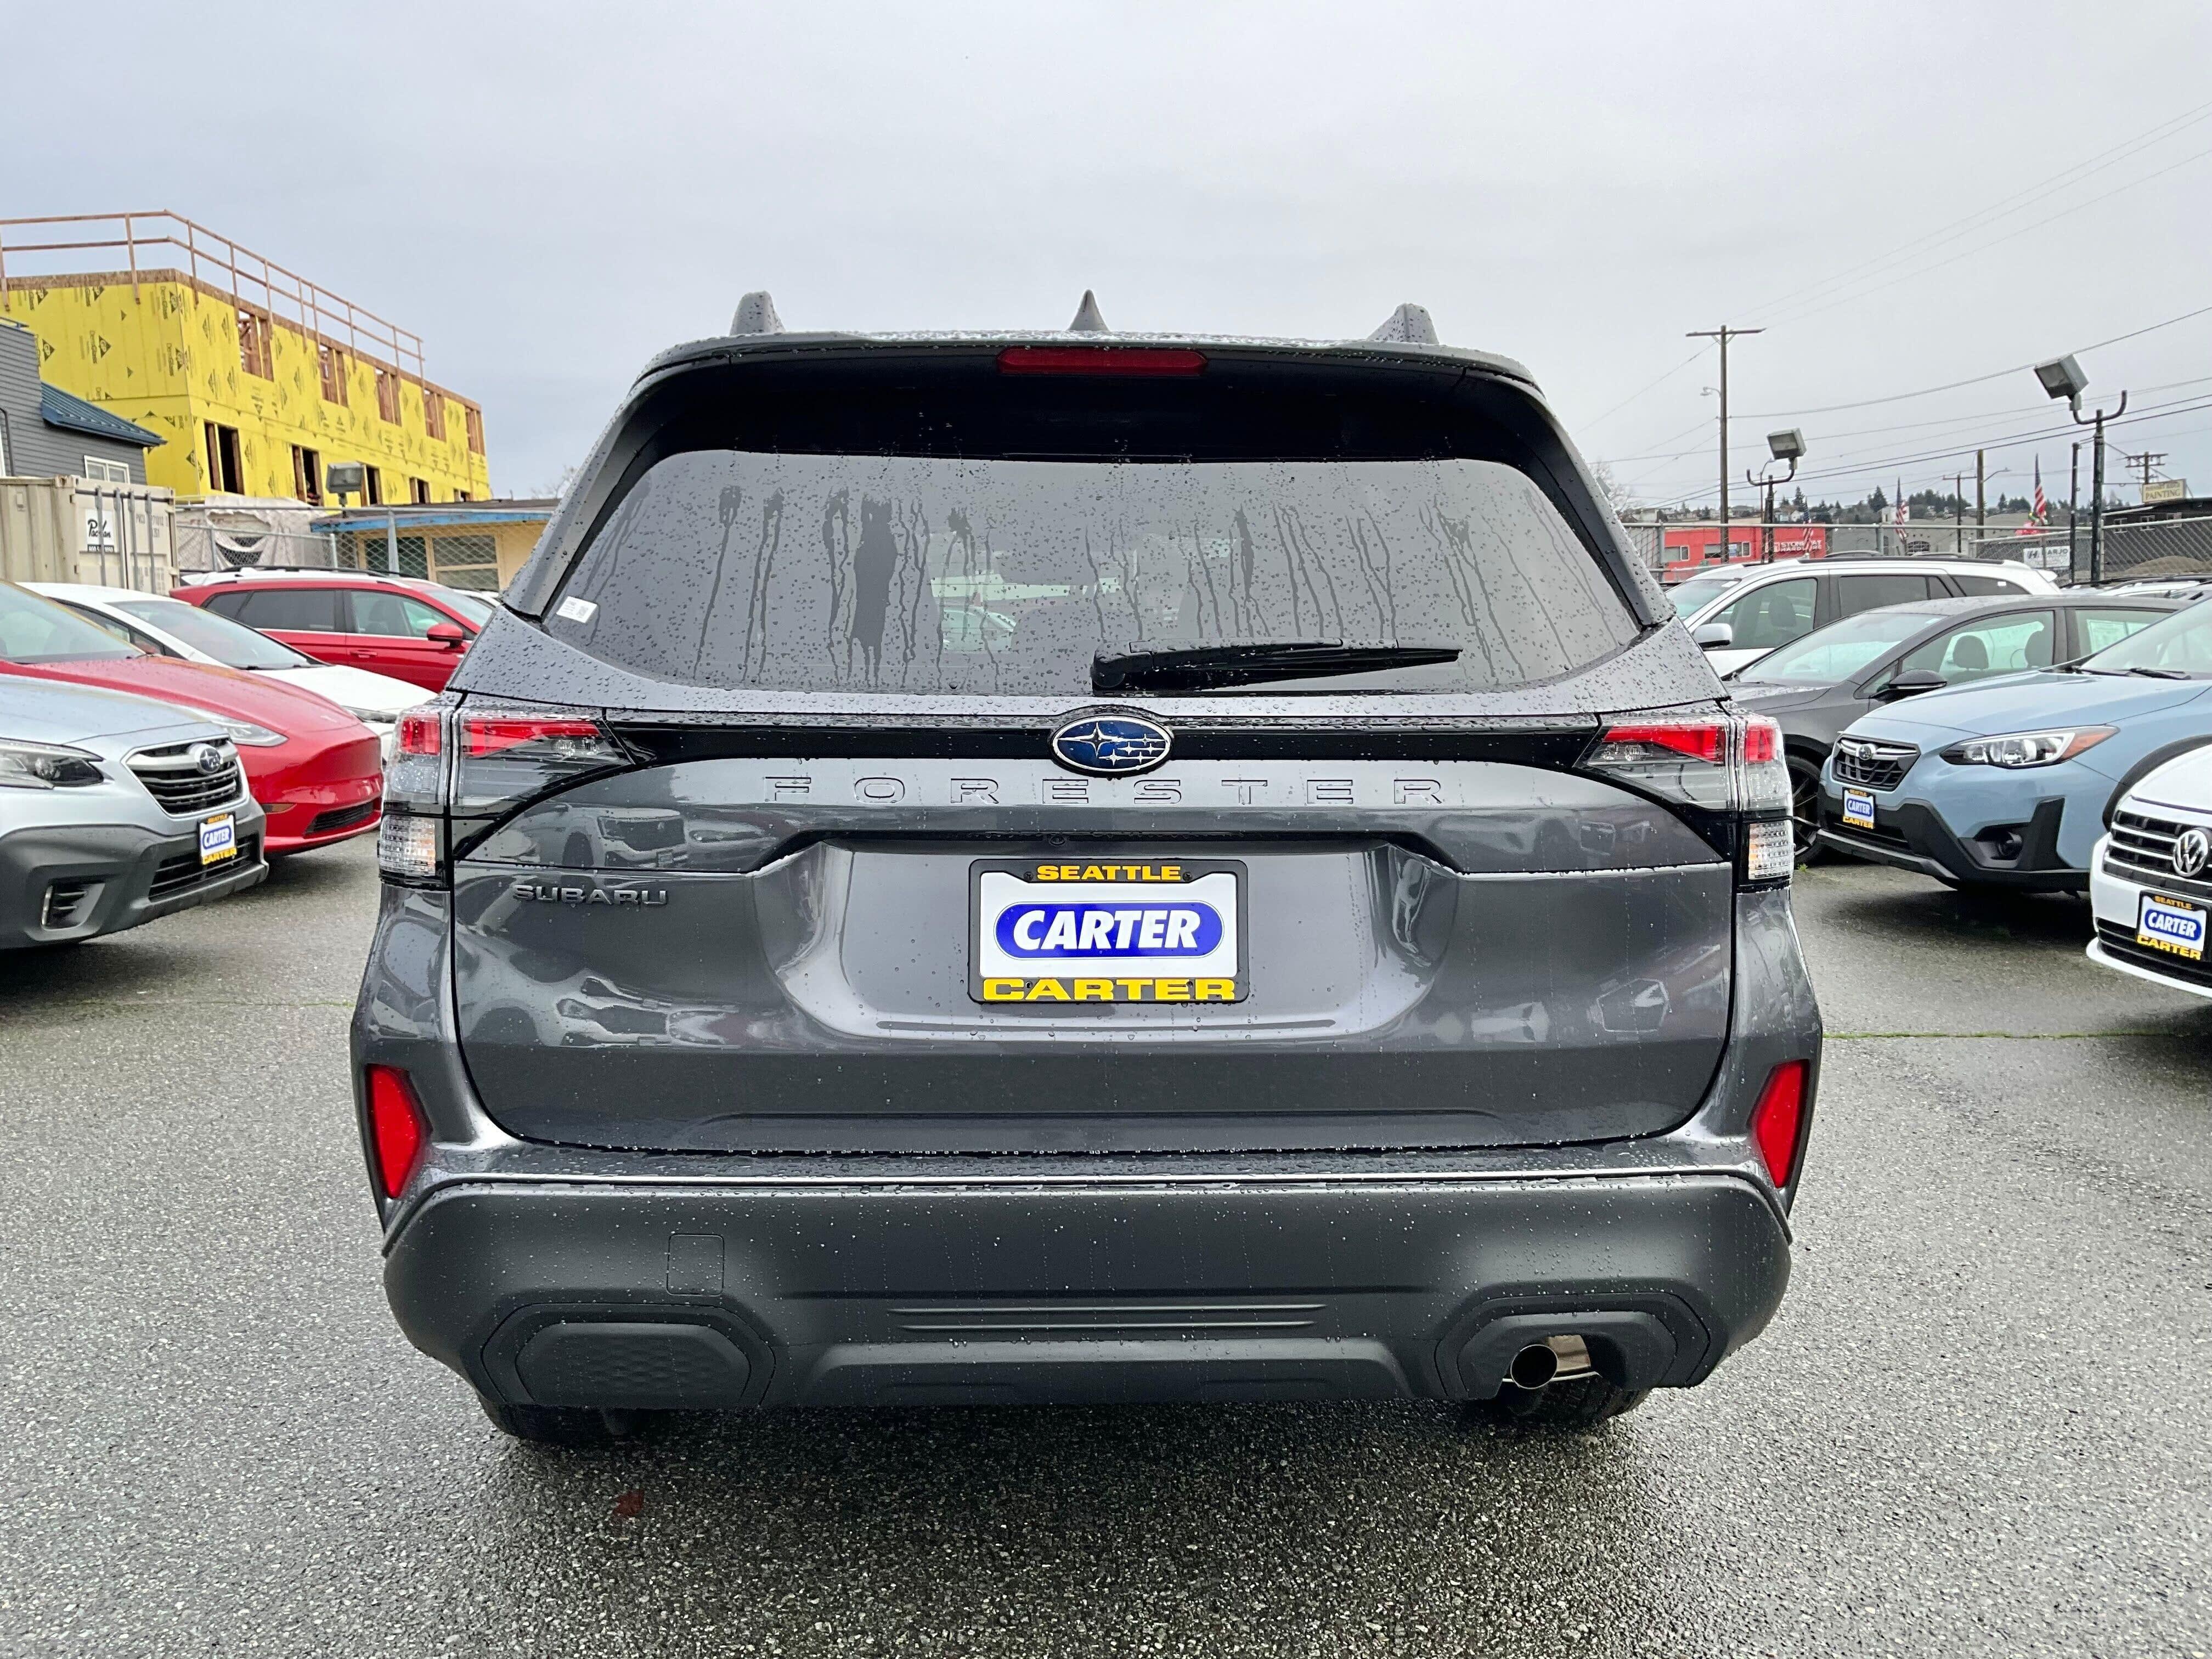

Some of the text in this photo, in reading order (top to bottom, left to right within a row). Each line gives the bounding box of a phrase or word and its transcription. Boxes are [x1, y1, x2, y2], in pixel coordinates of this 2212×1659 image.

[2146, 489, 2181, 500] PAINTING
[764, 776, 1442, 805] FORESTER
[1848, 799, 1871, 815] CARTER
[208, 813, 228, 823] SEATTLE
[1843, 816, 1874, 830] CARTER
[204, 827, 230, 847] CARTER
[202, 847, 237, 865] CARTER
[1036, 865, 1181, 881] SEATTLE
[512, 884, 668, 906] SUBARU
[2154, 895, 2193, 910] SEATTLE
[1013, 910, 1201, 950] CARTER
[2148, 912, 2197, 938] CARTER
[2136, 934, 2201, 961] CARTER
[983, 978, 1235, 1001] CARTER
